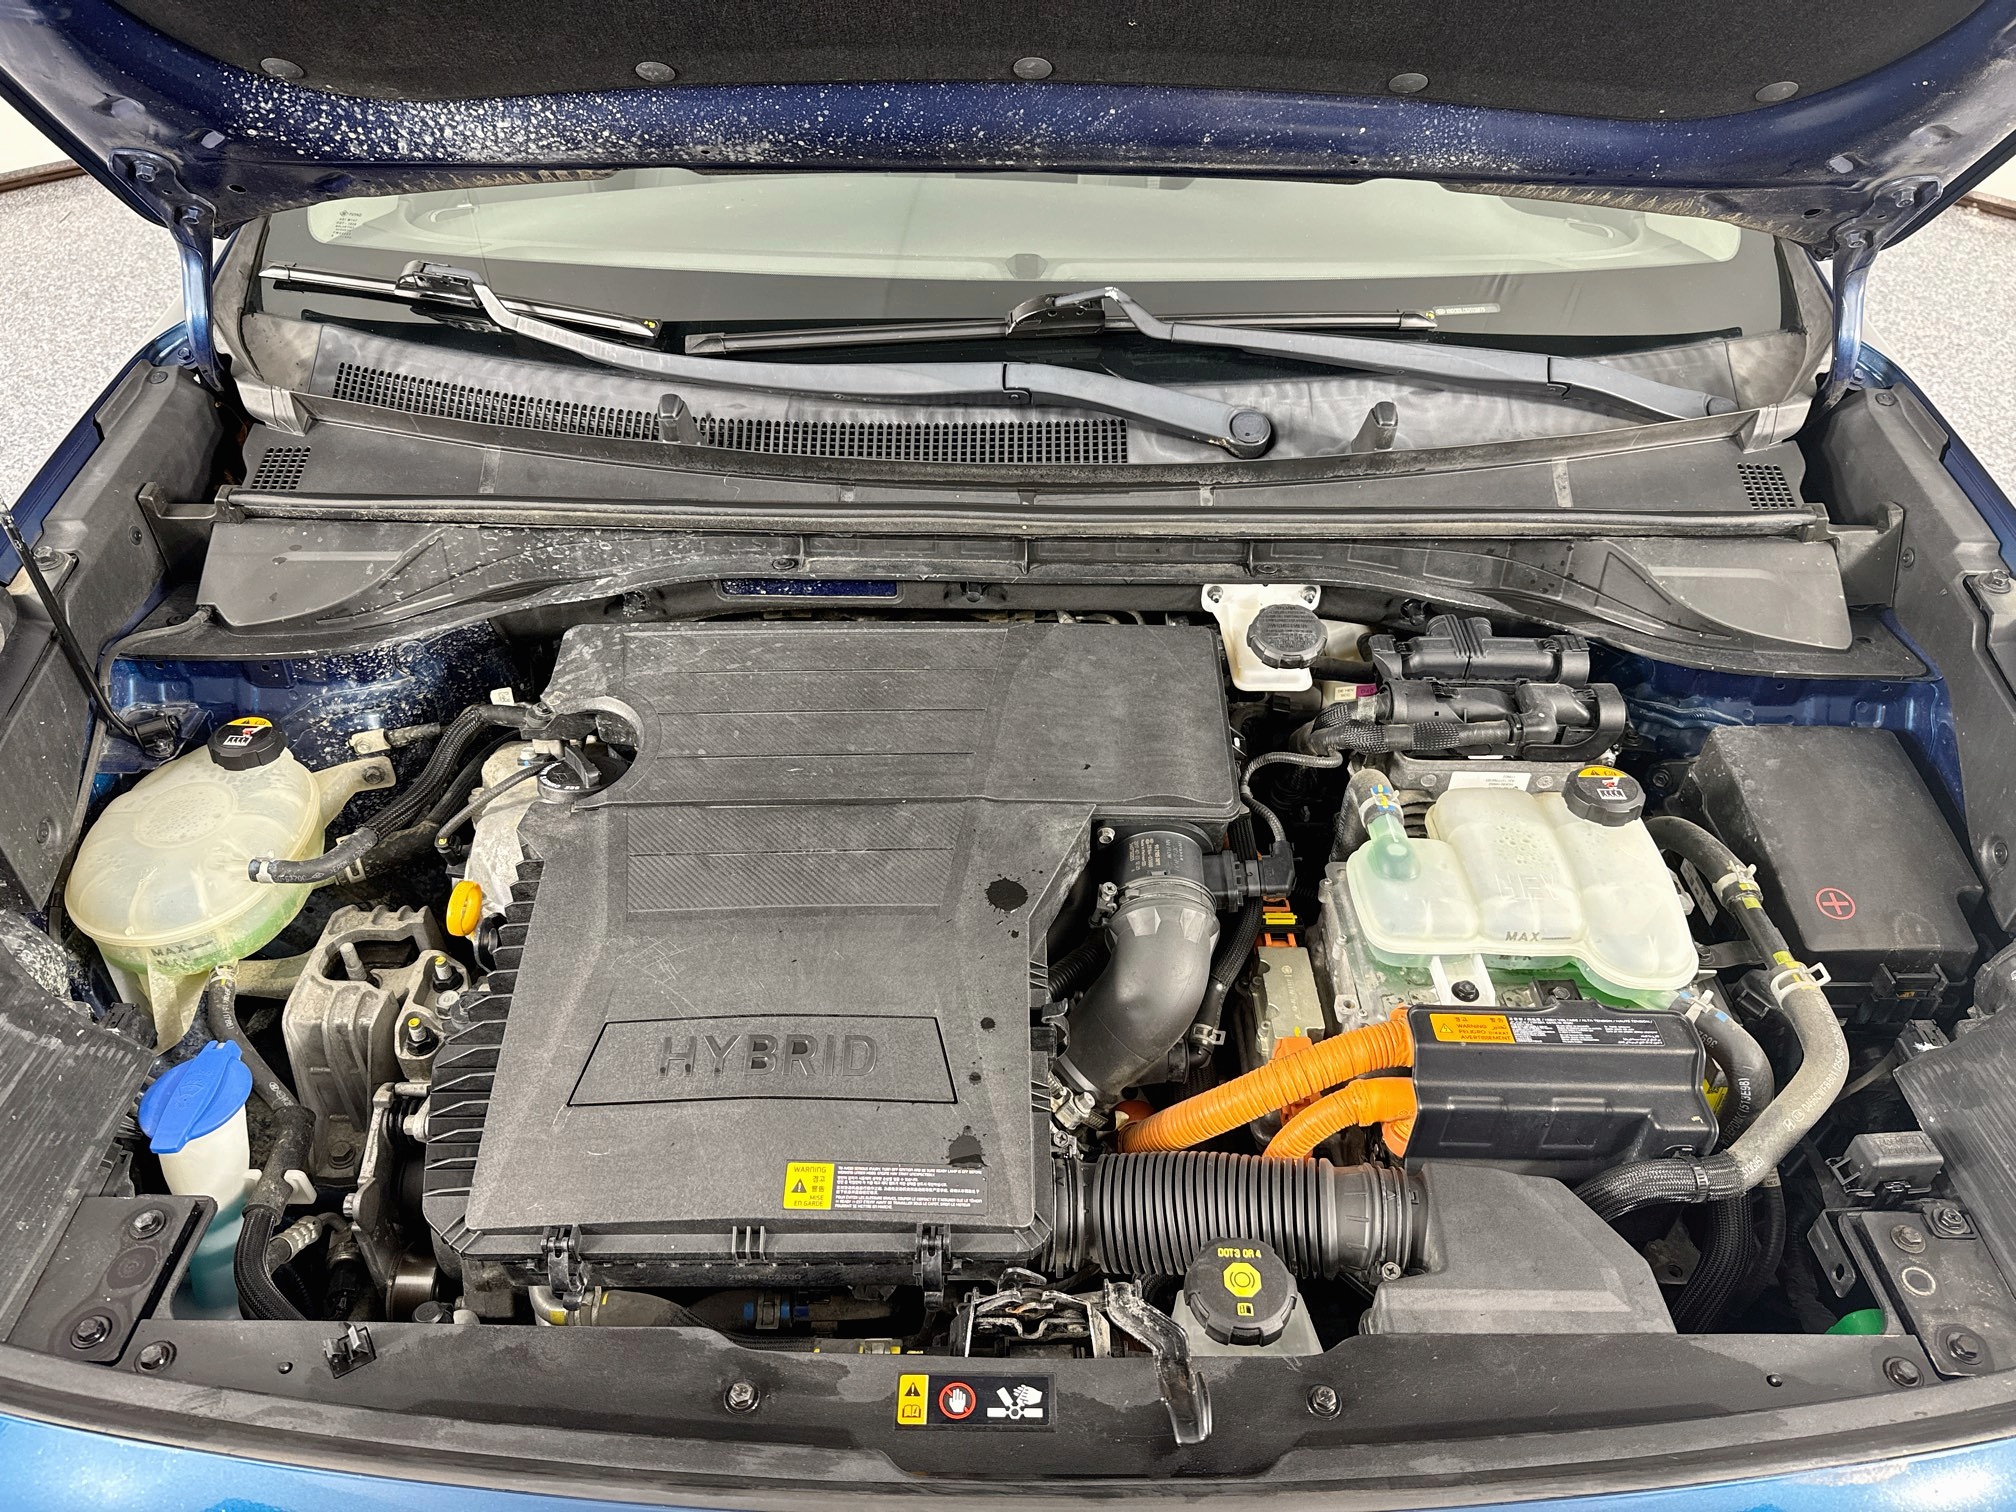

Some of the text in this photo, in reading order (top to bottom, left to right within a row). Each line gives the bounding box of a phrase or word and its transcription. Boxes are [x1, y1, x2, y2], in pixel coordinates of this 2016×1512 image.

[1505, 931, 1540, 942] MAX
[150, 944, 184, 957] MAX
[658, 1034, 878, 1078] HYBRID
[1217, 1247, 1262, 1259] DOT3 OR 4
